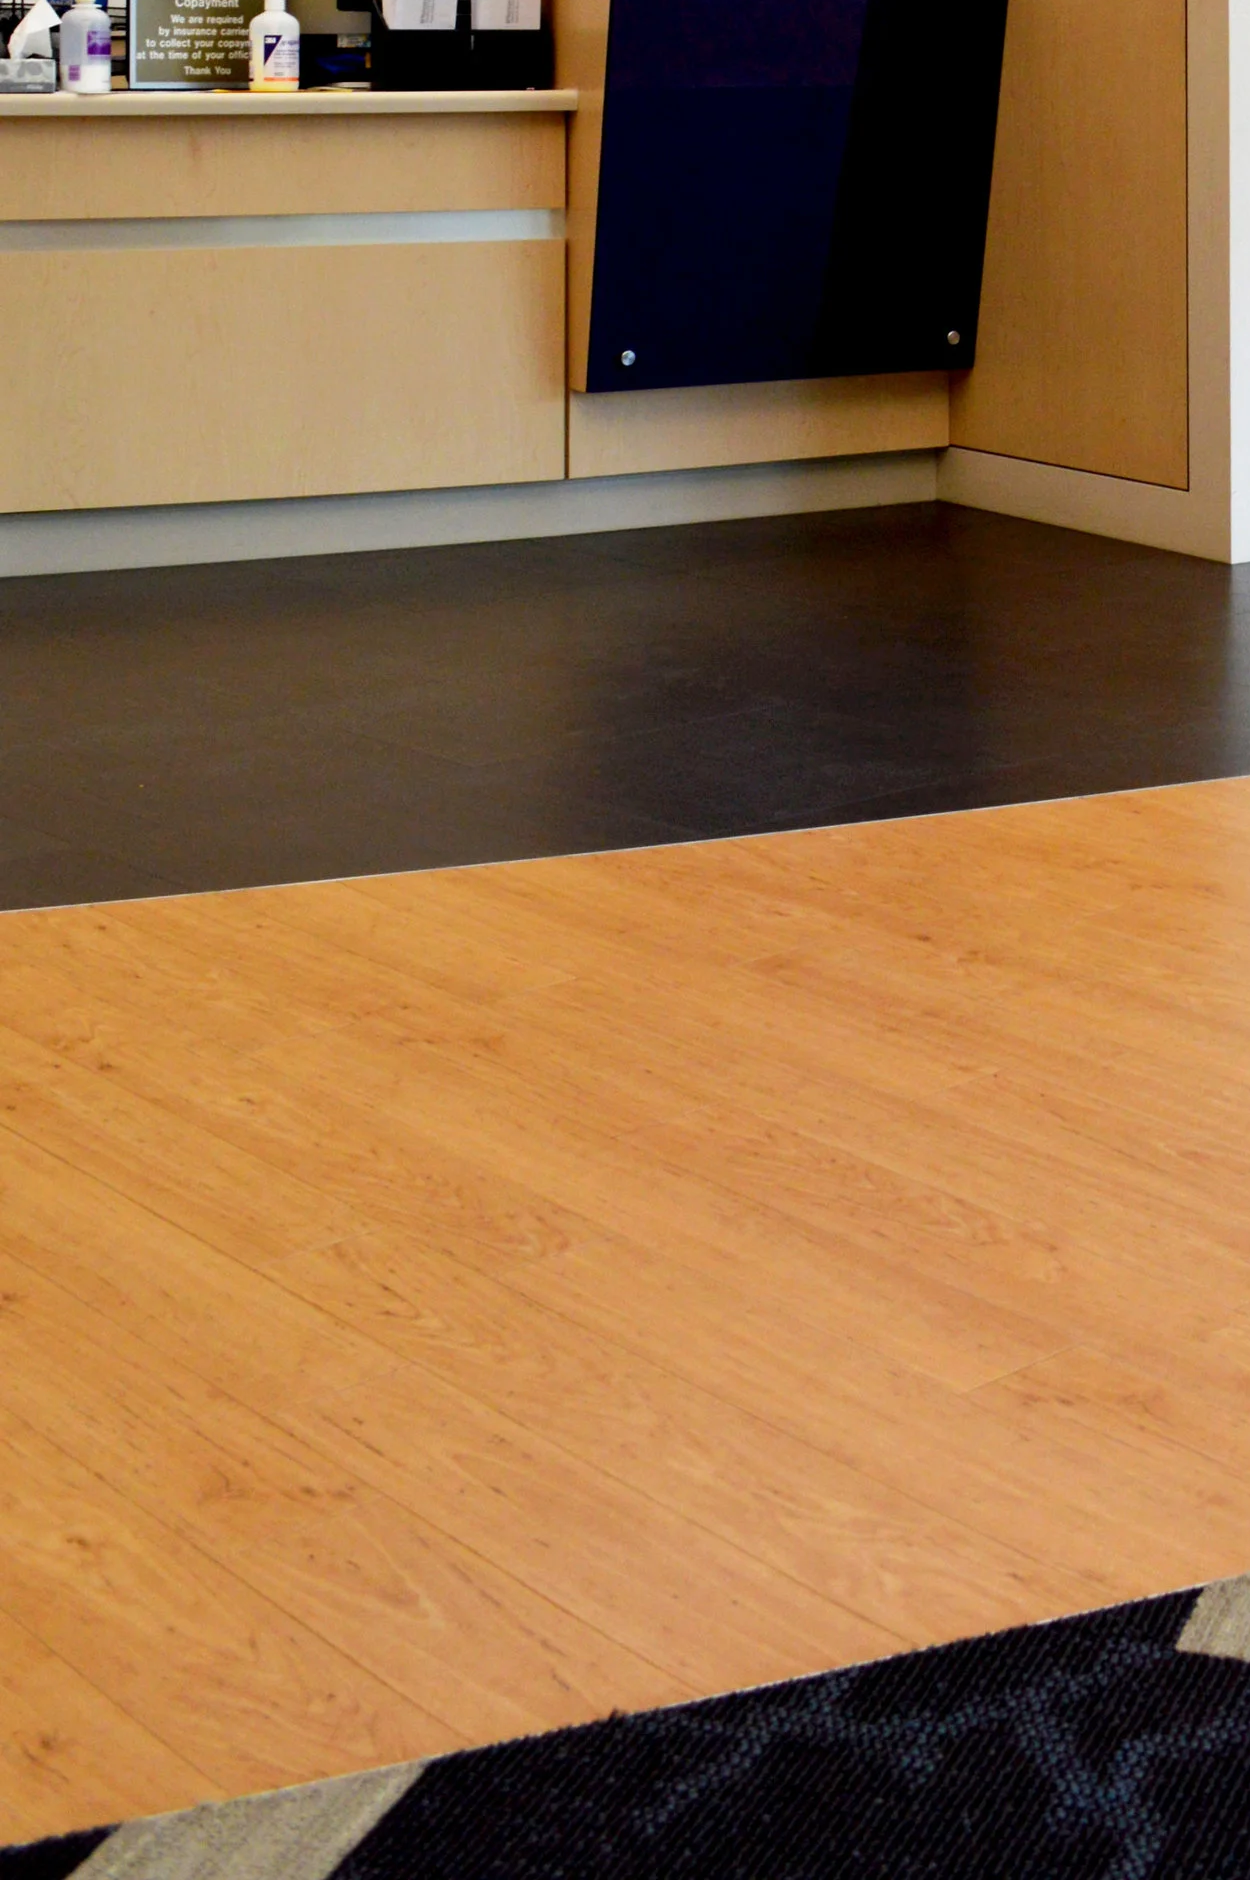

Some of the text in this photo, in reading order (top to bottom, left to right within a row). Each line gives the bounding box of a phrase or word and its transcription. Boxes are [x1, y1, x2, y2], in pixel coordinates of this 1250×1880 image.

[171, 14, 244, 25] We are required
[158, 26, 250, 37] by insurance carrier
[146, 38, 156, 48] to
[159, 38, 191, 48] collect
[194, 40, 214, 49] your
[183, 66, 232, 76] Thank You
